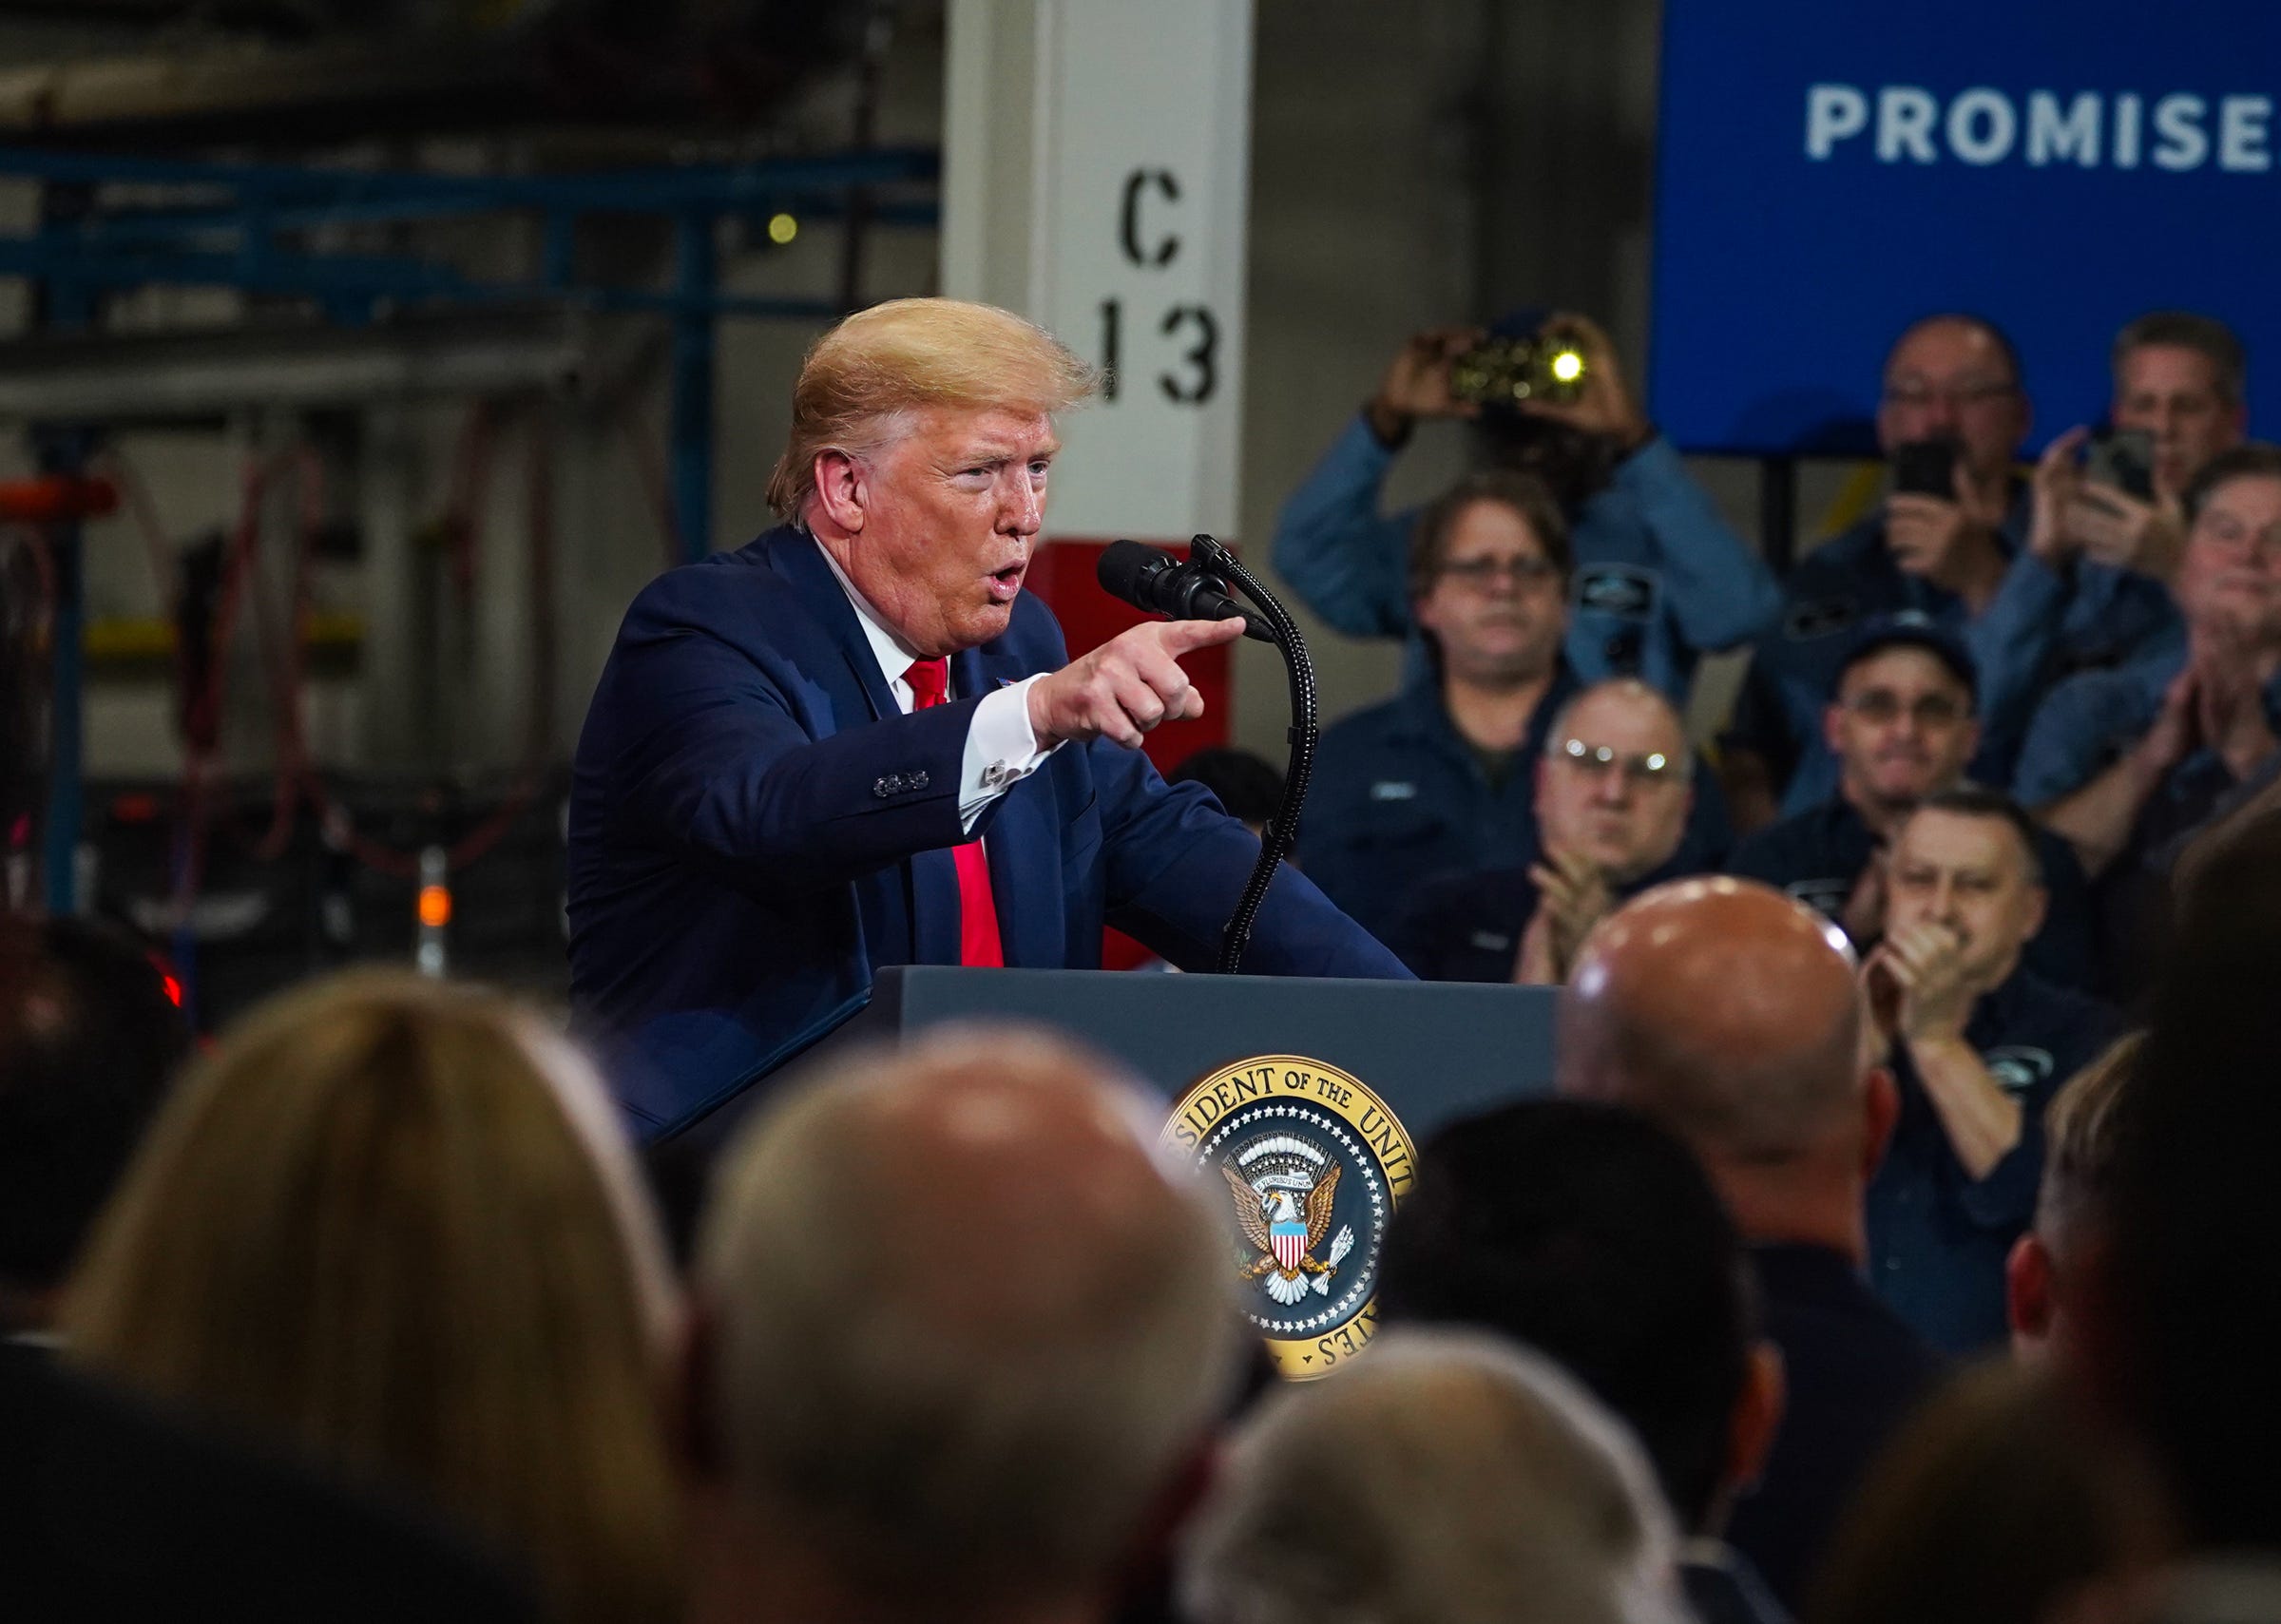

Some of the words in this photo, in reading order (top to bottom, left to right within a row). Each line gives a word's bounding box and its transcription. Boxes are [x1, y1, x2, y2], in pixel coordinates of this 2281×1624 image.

[1807, 84, 2272, 171] PROMISE
[1119, 165, 1180, 269] C
[1100, 296, 1219, 407] 13
[1172, 1066, 1275, 1153] SIDENT
[1284, 1070, 1312, 1090] OF
[1316, 1077, 1353, 1110] THE
[1293, 1179, 1312, 1188] UNUM
[1359, 1104, 1414, 1199] UNIT
[1317, 1309, 1378, 1366] TES
